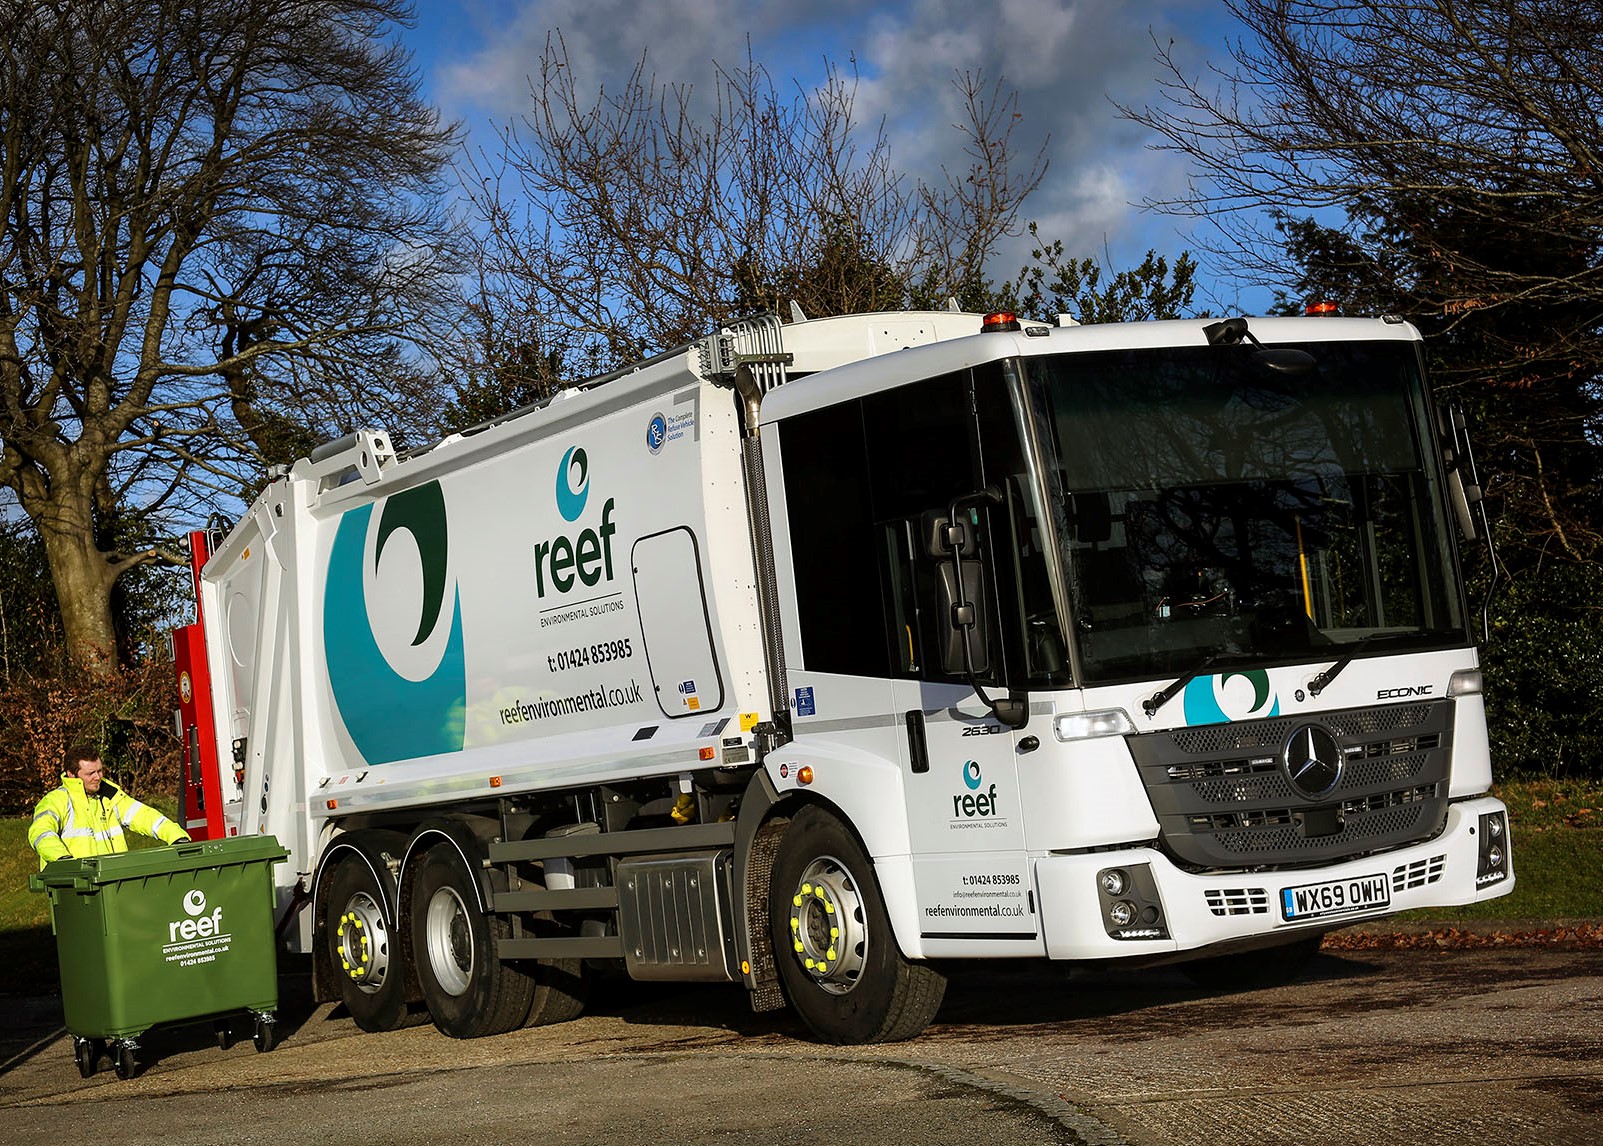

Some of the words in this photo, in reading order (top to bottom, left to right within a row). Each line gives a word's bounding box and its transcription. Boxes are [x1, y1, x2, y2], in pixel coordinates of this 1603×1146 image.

[534, 497, 616, 599] reef
[540, 609, 589, 628] ENVIRONMENTAL
[589, 600, 624, 617] SOLUTIONS
[547, 655, 557, 672] t:
[557, 647, 590, 671] 01424
[590, 638, 633, 664] 853985
[1377, 685, 1433, 700] ECONIC
[499, 678, 644, 725] reefenvironmental.co.uk
[962, 725, 1000, 736] 2630
[953, 783, 997, 817] reef
[962, 876, 969, 885] t:
[969, 875, 991, 885] 01424
[992, 874, 1020, 885] 853985
[953, 890, 1022, 899] info@reefenvironmental.co.uk
[1295, 885, 1345, 912] WX69
[1349, 879, 1385, 904] OWH
[925, 904, 1024, 917] reefenvironmental.co.uk
[169, 906, 222, 942] reef
[162, 942, 204, 954] ENVIRONMENTAL
[205, 937, 232, 946] SOLUTIONS
[165, 945, 229, 962] reefenvironmental.co.uk
[180, 959, 197, 967] 01424
